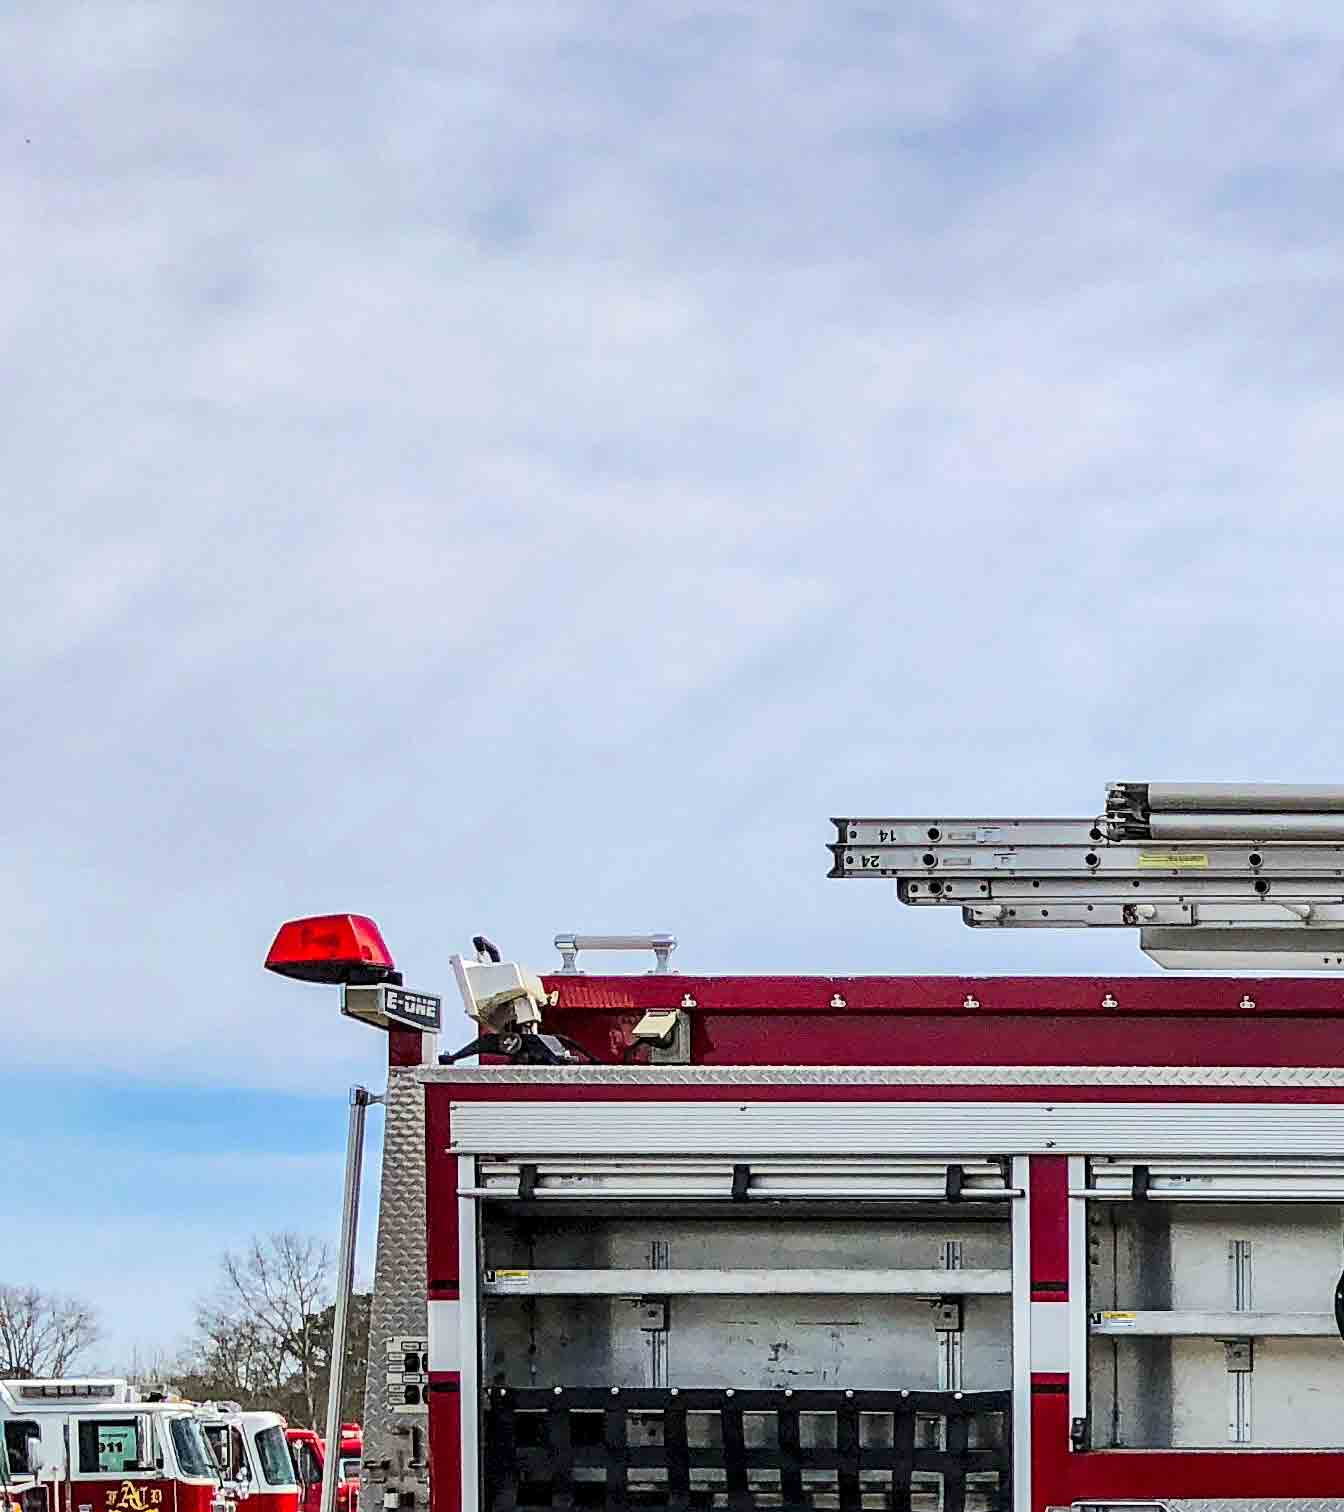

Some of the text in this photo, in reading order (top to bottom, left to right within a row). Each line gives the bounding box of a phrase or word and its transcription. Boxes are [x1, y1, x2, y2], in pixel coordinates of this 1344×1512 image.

[880, 829, 897, 843] 14
[861, 855, 880, 868] 24
[386, 991, 437, 1018] E-ONE
